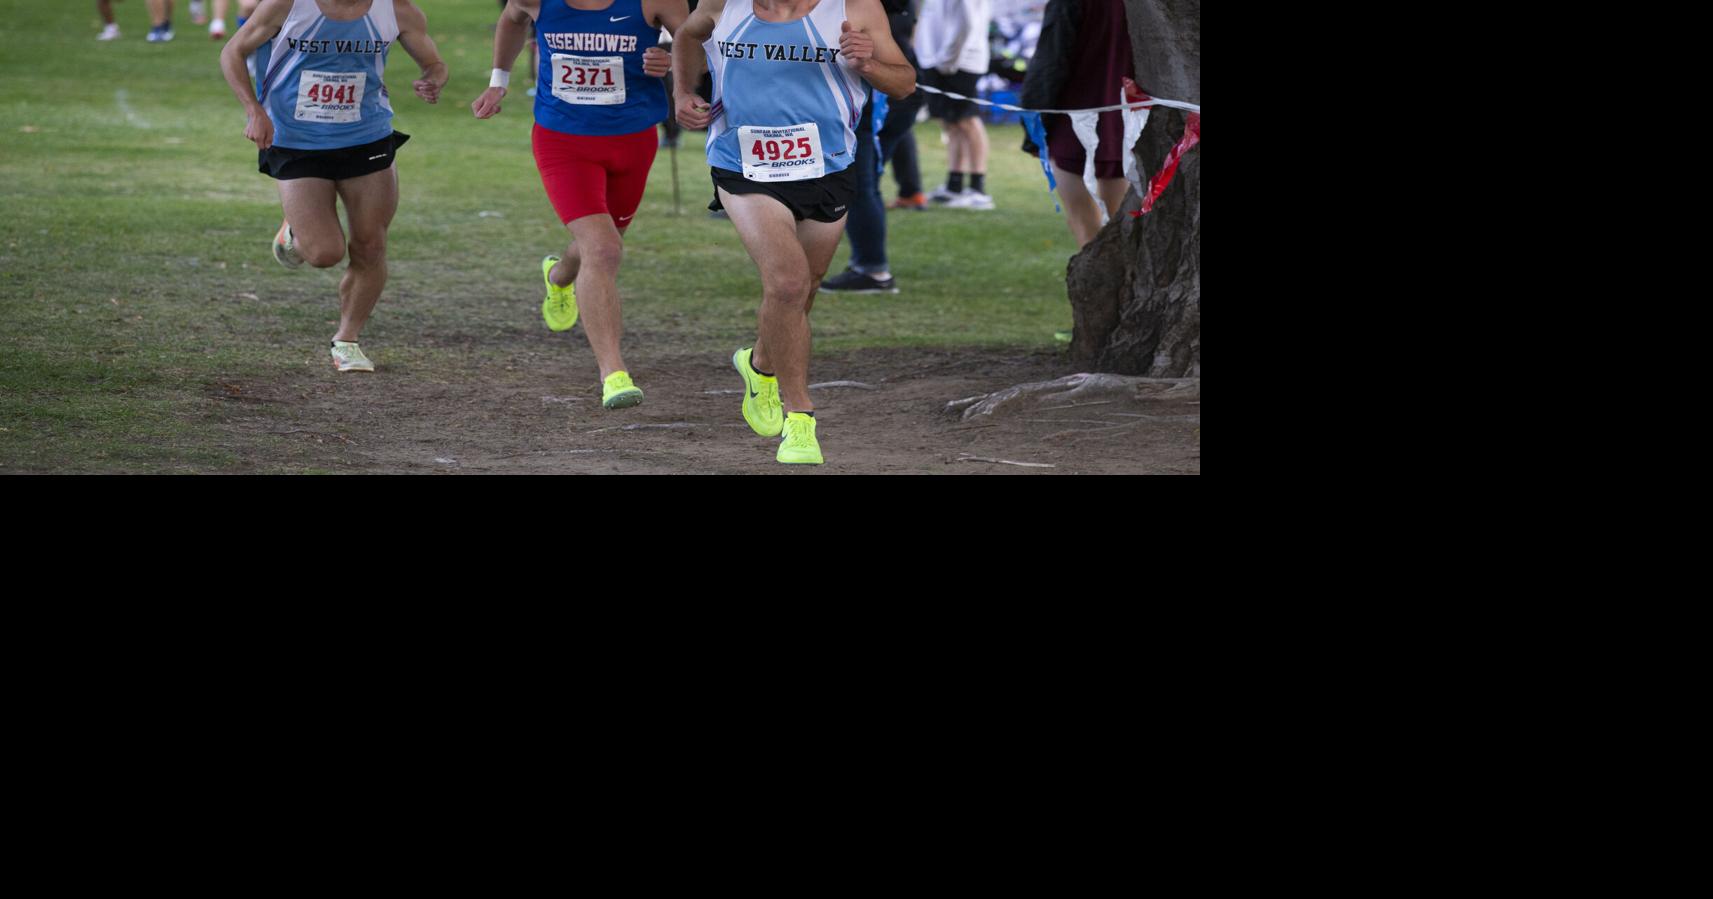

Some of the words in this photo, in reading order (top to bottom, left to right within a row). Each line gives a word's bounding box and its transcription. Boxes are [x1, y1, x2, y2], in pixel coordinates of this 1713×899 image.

[287, 37, 330, 53] WEST
[544, 32, 638, 52] EISENHOWER
[764, 44, 841, 63] VALLEY
[561, 64, 615, 86] 2371
[308, 83, 356, 104] 4941
[751, 137, 812, 161] 4925
[771, 158, 816, 168] BROOKS
